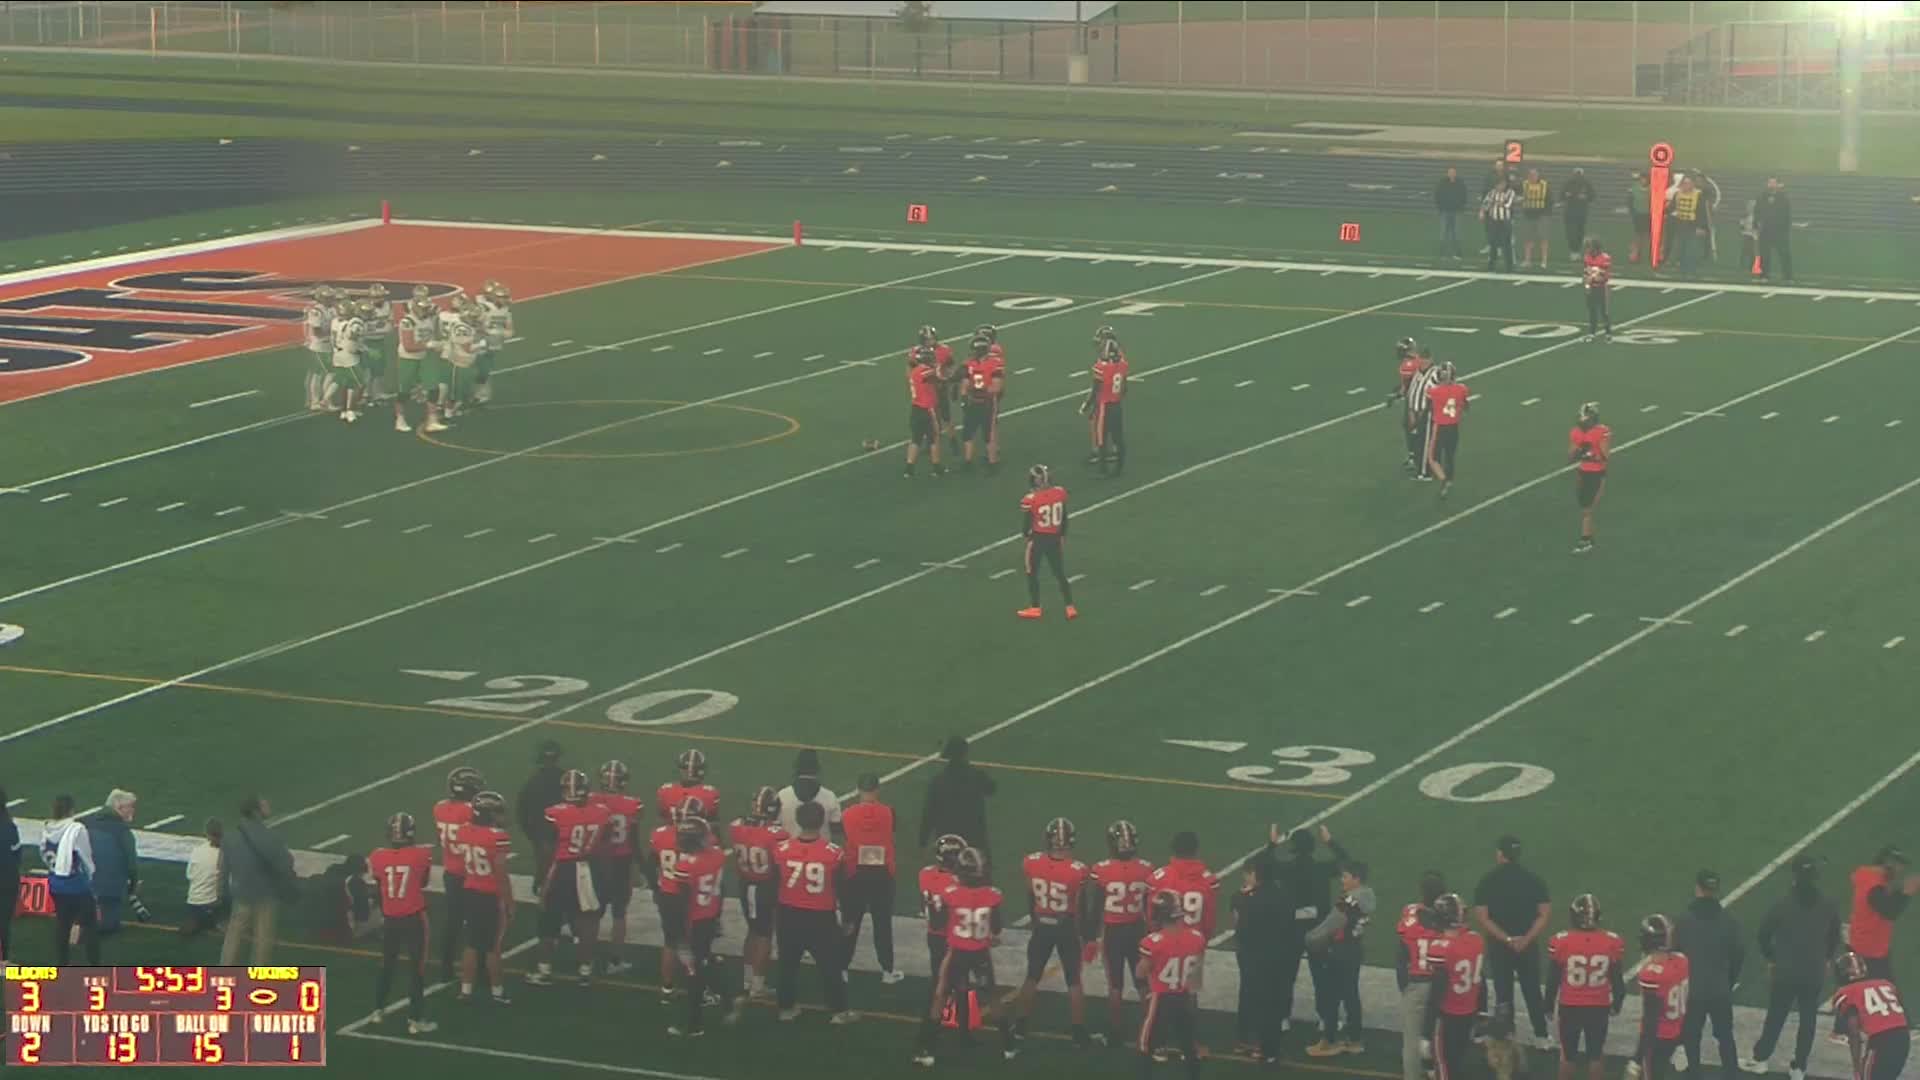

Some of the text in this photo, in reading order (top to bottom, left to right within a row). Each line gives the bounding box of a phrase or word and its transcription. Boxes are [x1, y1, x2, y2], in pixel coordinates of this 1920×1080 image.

[1507, 142, 1521, 162] 2
[1112, 373, 1122, 393] 8
[1442, 398, 1456, 418] 4
[1037, 501, 1063, 528] 30
[568, 825, 600, 853] 97
[384, 865, 410, 898] 17
[786, 860, 825, 893] 79
[21, 883, 46, 911] 20
[1032, 878, 1068, 911] 85
[1105, 882, 1146, 913] 23
[954, 907, 991, 940] 38
[1567, 955, 1609, 987] 62
[1864, 986, 1904, 1016] 45
